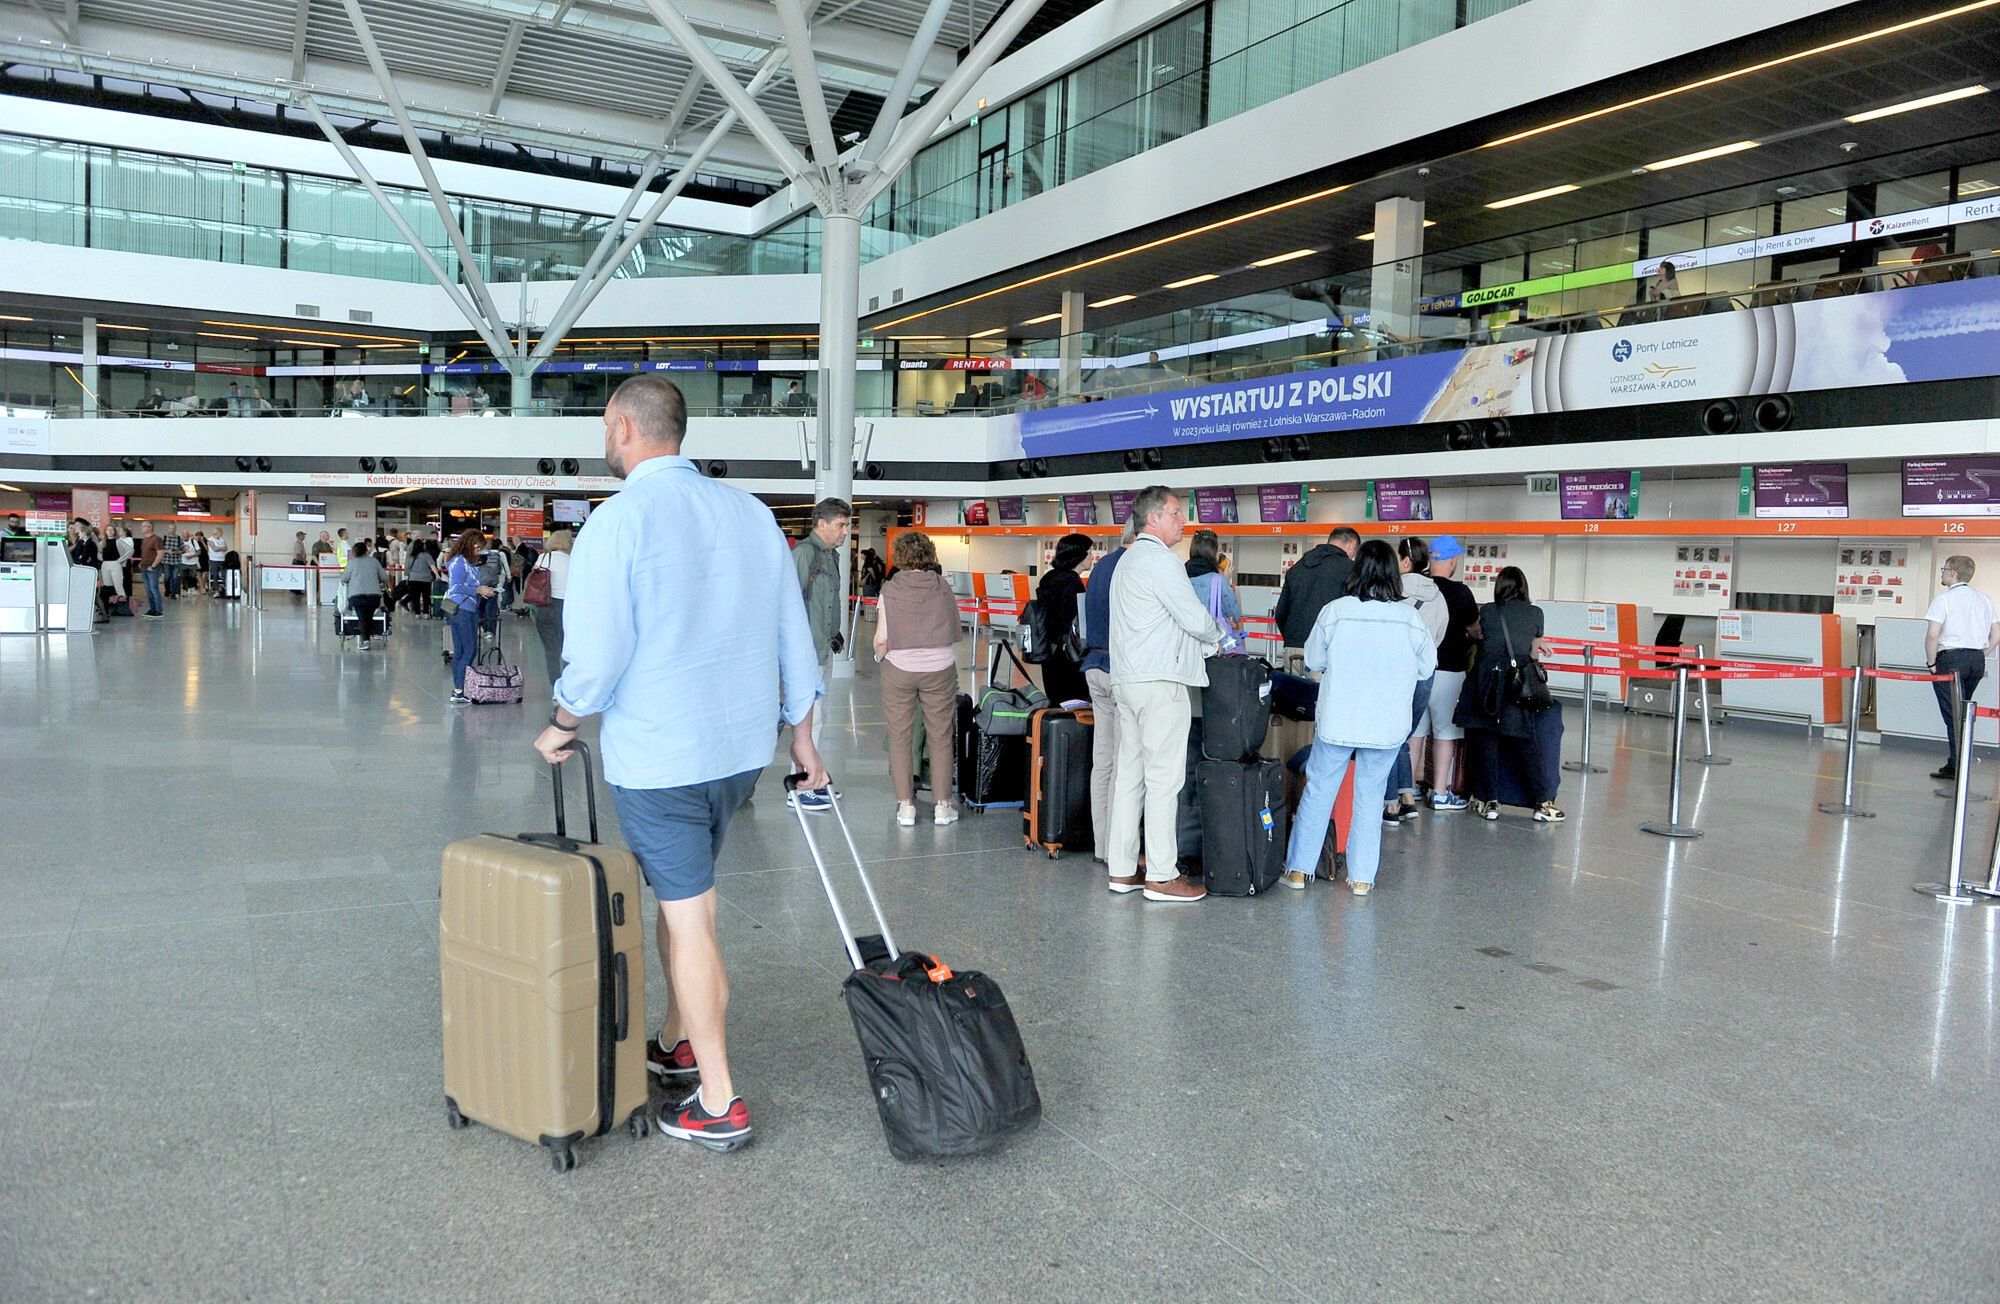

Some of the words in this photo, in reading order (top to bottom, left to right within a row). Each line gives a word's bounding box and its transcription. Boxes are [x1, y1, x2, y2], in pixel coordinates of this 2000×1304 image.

[1965, 203, 1994, 217] Rent
[1886, 217, 1930, 230] KaizenRent
[1766, 241, 1784, 250] Rent
[1794, 236, 1816, 246] Drive
[1466, 286, 1515, 304] GOLDCAR
[1431, 297, 1456, 310] rental
[1615, 347, 1629, 355] PPL
[1636, 343, 1659, 354] Porty
[1661, 338, 1699, 350] Lotnicze
[655, 362, 670, 370] LOT
[900, 360, 928, 369] Quanta
[1610, 373, 1645, 384] LOTNISKO
[1170, 384, 1285, 421] WYSTARTUJ
[1289, 382, 1303, 407] Z
[1308, 371, 1392, 405] POLSKI
[1172, 427, 1181, 437] W
[1181, 427, 1198, 436] 2023
[1199, 424, 1215, 435] roku
[1263, 419, 1268, 428] z
[1269, 414, 1302, 427] Lotniska
[366, 474, 404, 485] Kontrola
[484, 475, 522, 488] Security
[525, 476, 557, 487] Check
[915, 503, 923, 525] B
[1388, 525, 1399, 533] 129
[1584, 523, 1599, 532] 128
[1777, 523, 1796, 532] 127
[1943, 522, 1965, 533] 126
